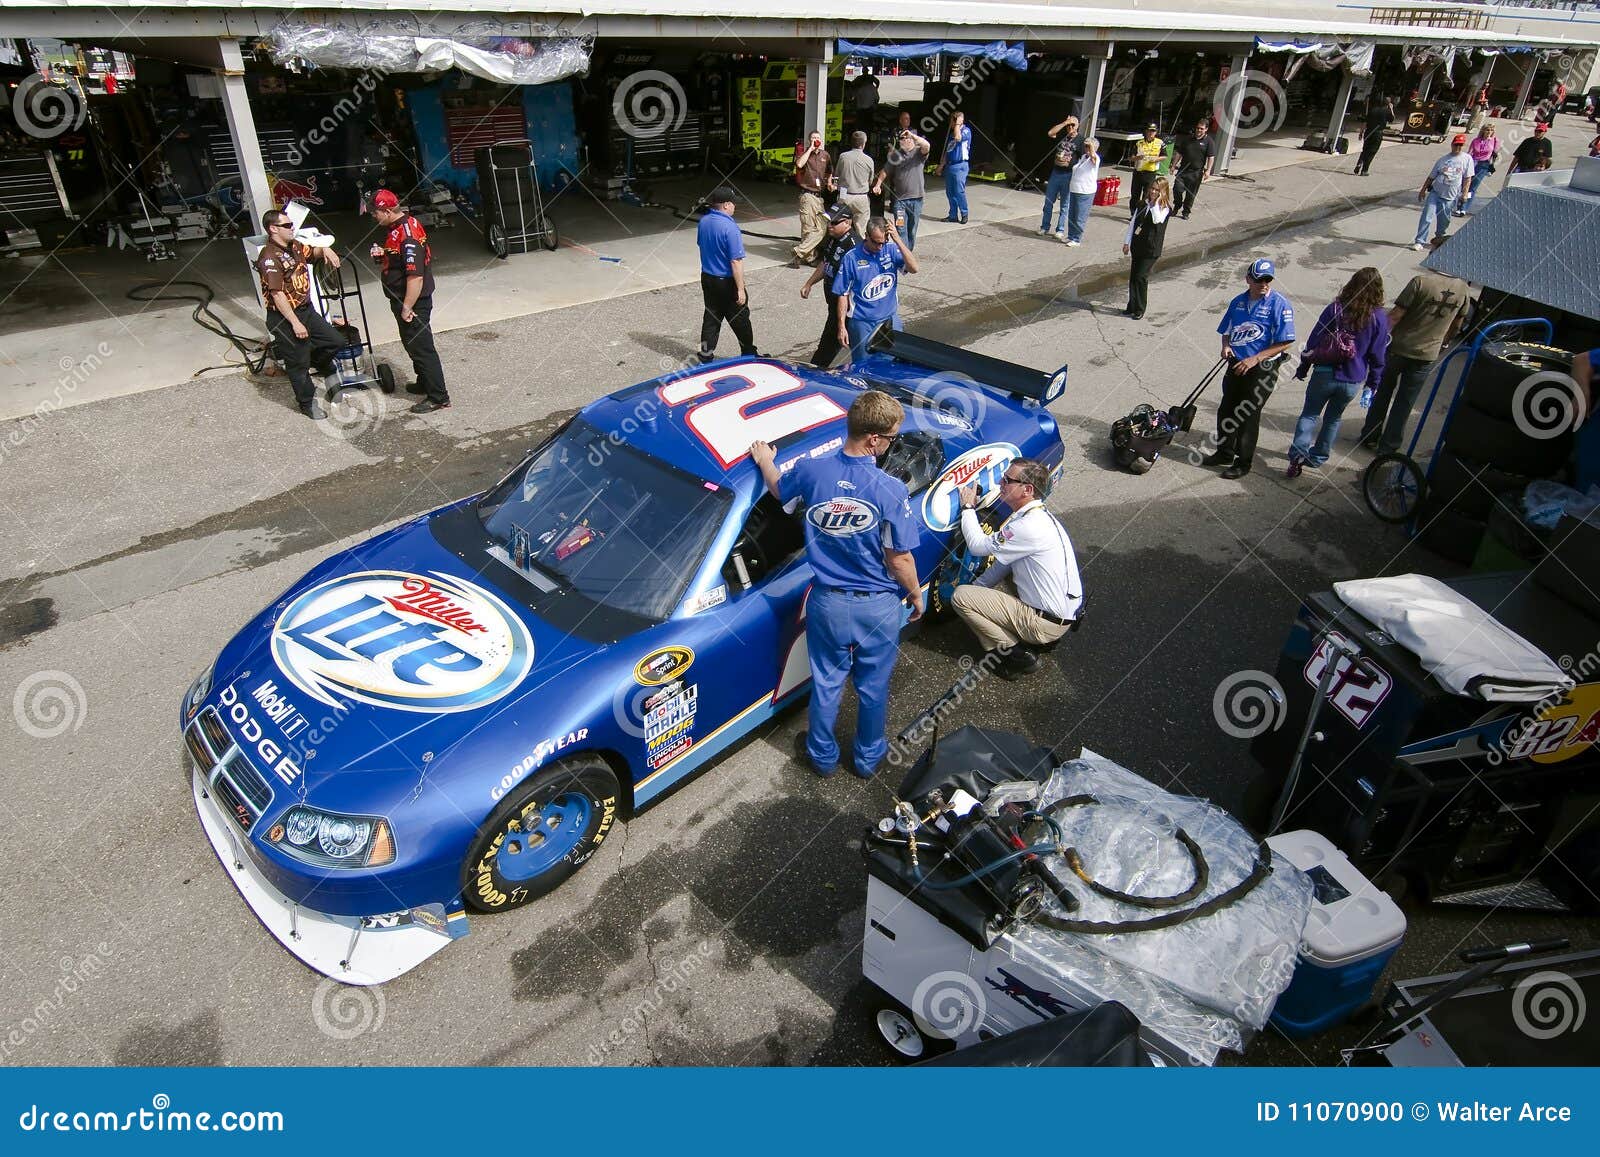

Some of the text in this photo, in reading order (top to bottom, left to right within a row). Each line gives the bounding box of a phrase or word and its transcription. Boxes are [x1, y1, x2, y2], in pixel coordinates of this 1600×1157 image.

[67, 149, 84, 160] 71
[869, 278, 891, 299] Lite
[656, 361, 849, 473] 2
[943, 454, 993, 484] Miller
[820, 511, 868, 530] Lite
[828, 501, 858, 512] Miller
[385, 578, 489, 636] Miller
[277, 594, 484, 686] Lite
[655, 658, 676, 676] Sprint
[251, 679, 306, 737] Mobil 1
[645, 700, 697, 740] MAHLE
[646, 696, 681, 725] Mobil
[219, 685, 302, 786] DODGE
[647, 715, 695, 752] MOOG
[649, 738, 685, 763] LINCOLN
[1507, 714, 1580, 761] 82
[490, 727, 590, 801] GOODYEAR
[591, 796, 616, 845] EAGLE
